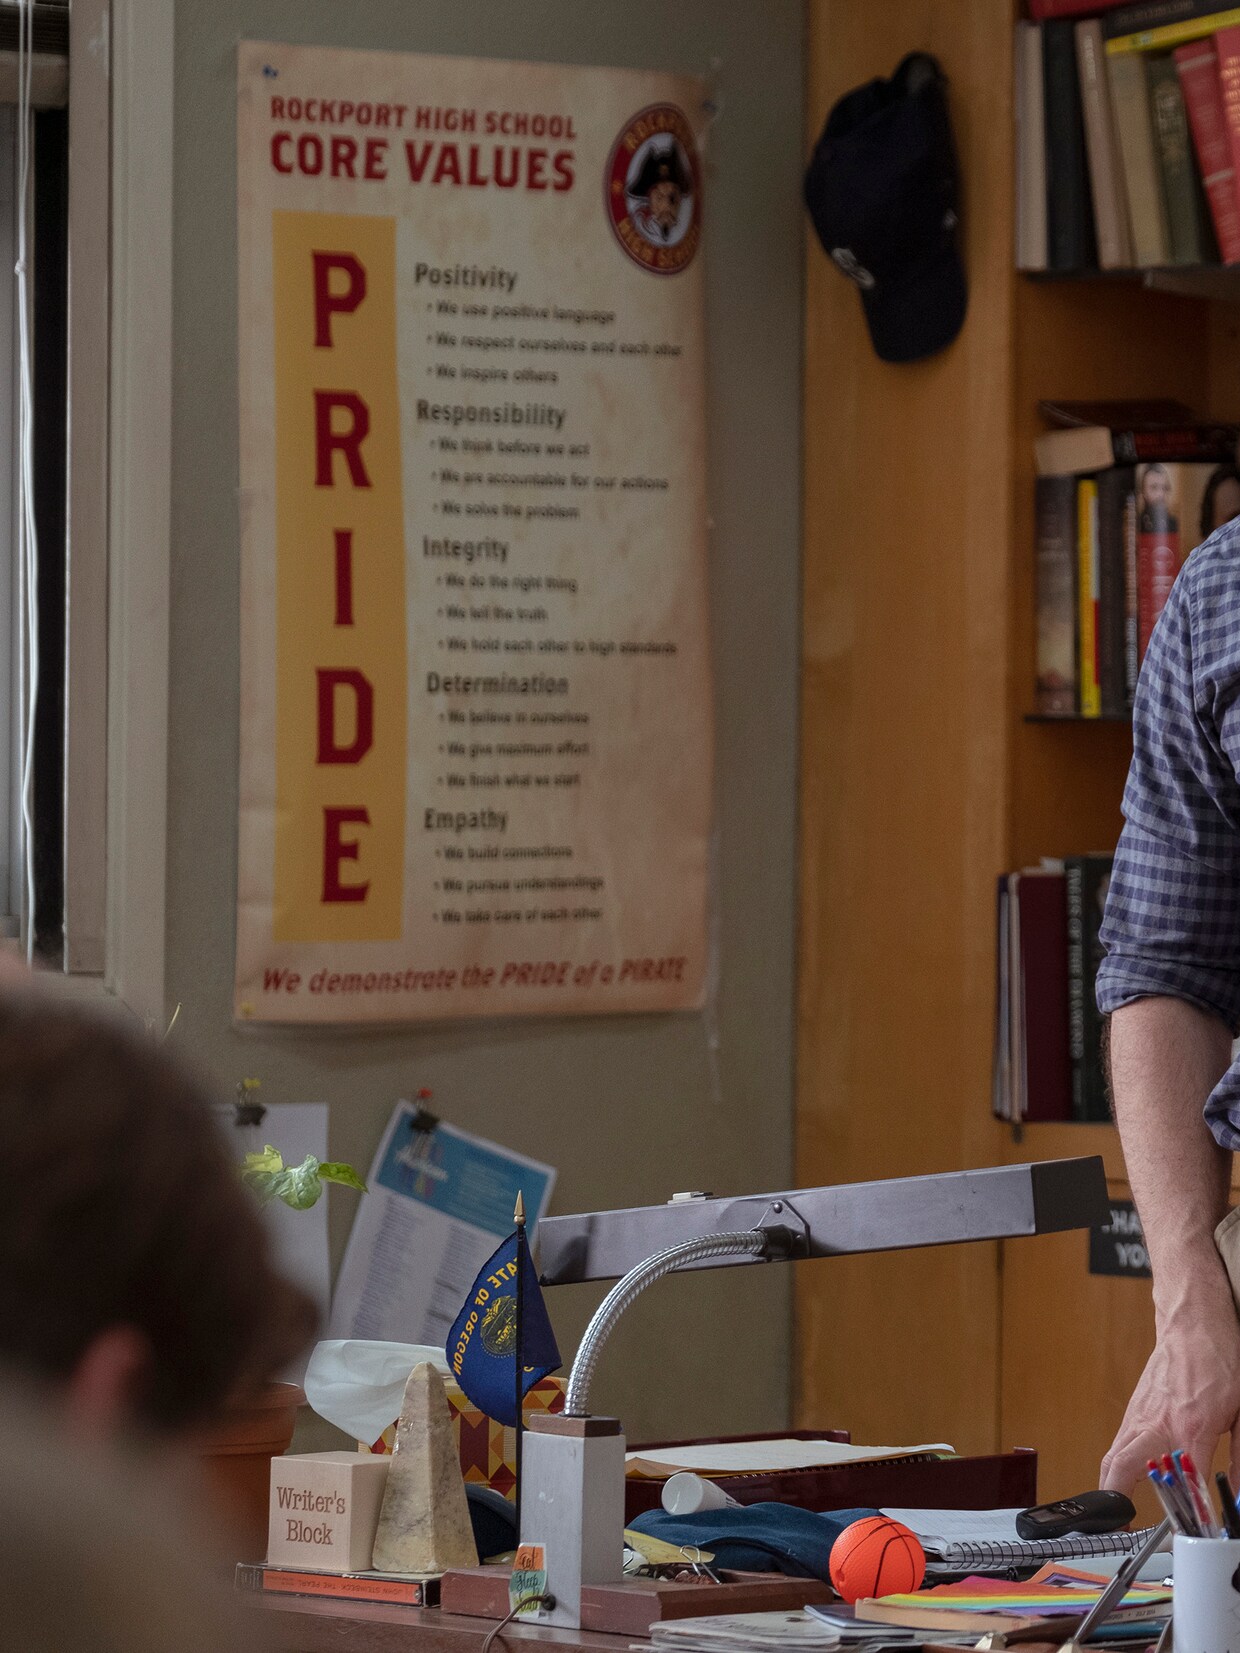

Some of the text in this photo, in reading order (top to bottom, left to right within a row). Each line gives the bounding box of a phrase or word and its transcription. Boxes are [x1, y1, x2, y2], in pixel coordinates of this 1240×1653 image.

[270, 95, 577, 141] ROCKPORT HIGH SCHOOL
[271, 130, 576, 193] CORE VALUES
[415, 262, 517, 292] Positivity
[436, 301, 457, 315] We
[552, 307, 616, 324] language
[436, 332, 456, 346] We
[436, 365, 456, 379] We
[416, 399, 566, 429] Responsibility
[439, 437, 458, 451] We
[440, 468, 460, 482] We
[441, 501, 461, 515] We
[423, 535, 508, 564] Integrity
[311, 249, 374, 905] PRIDE
[426, 671, 569, 695] Determination
[424, 807, 508, 833] Empathy
[262, 956, 688, 994] We demonstrate the PRIDE of a PIRATE
[276, 1486, 346, 1515] Writer's
[286, 1519, 333, 1546] Block
